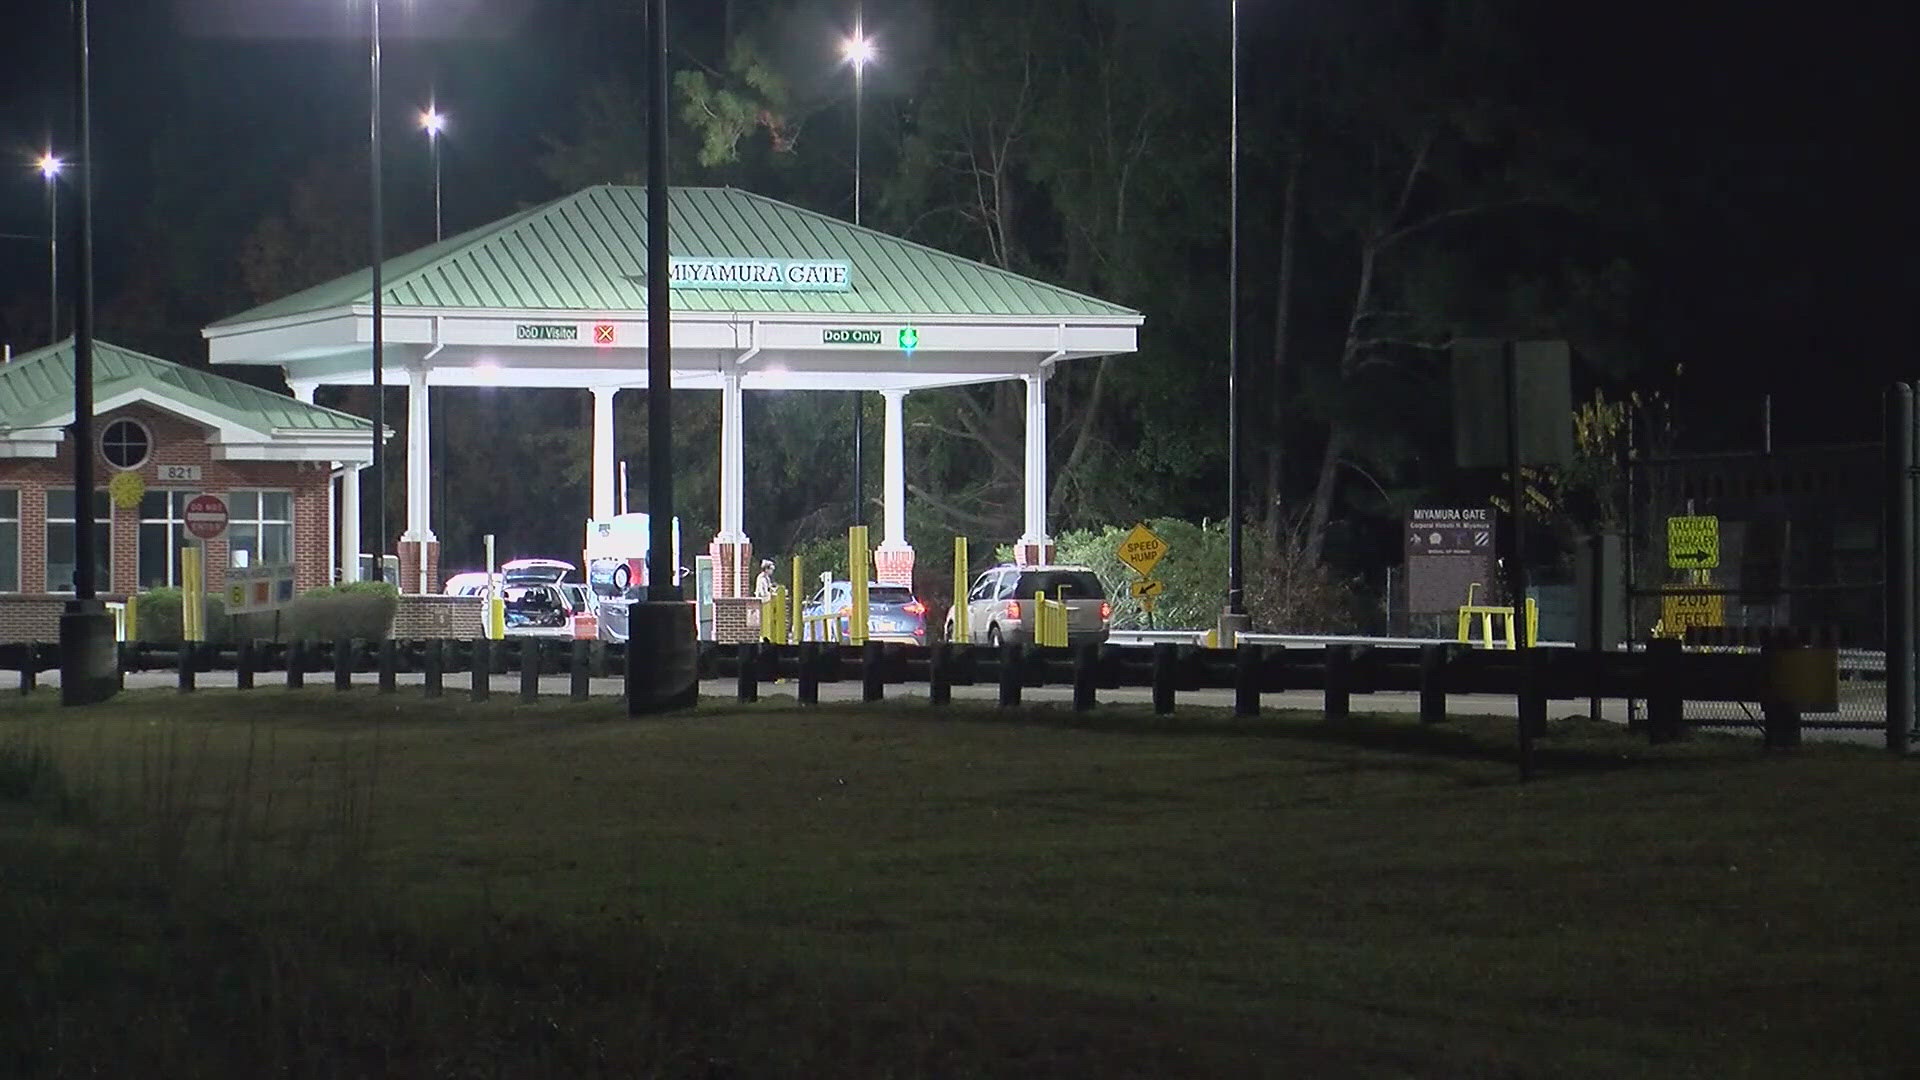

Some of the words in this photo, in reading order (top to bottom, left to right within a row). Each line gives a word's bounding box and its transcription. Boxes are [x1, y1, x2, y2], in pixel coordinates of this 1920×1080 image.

[788, 266, 846, 283] GATE
[518, 326, 539, 338] DoD
[545, 326, 576, 338] Visitor
[824, 330, 850, 341] DoD
[852, 330, 880, 344] Only
[168, 467, 192, 478] 821
[1413, 509, 1461, 520] MIYAMURA
[1462, 509, 1486, 520] GATE
[1127, 540, 1159, 553] SPEED
[1130, 551, 1158, 562] HUMP
[1678, 595, 1709, 606] 200
[1675, 612, 1713, 625] FEET
